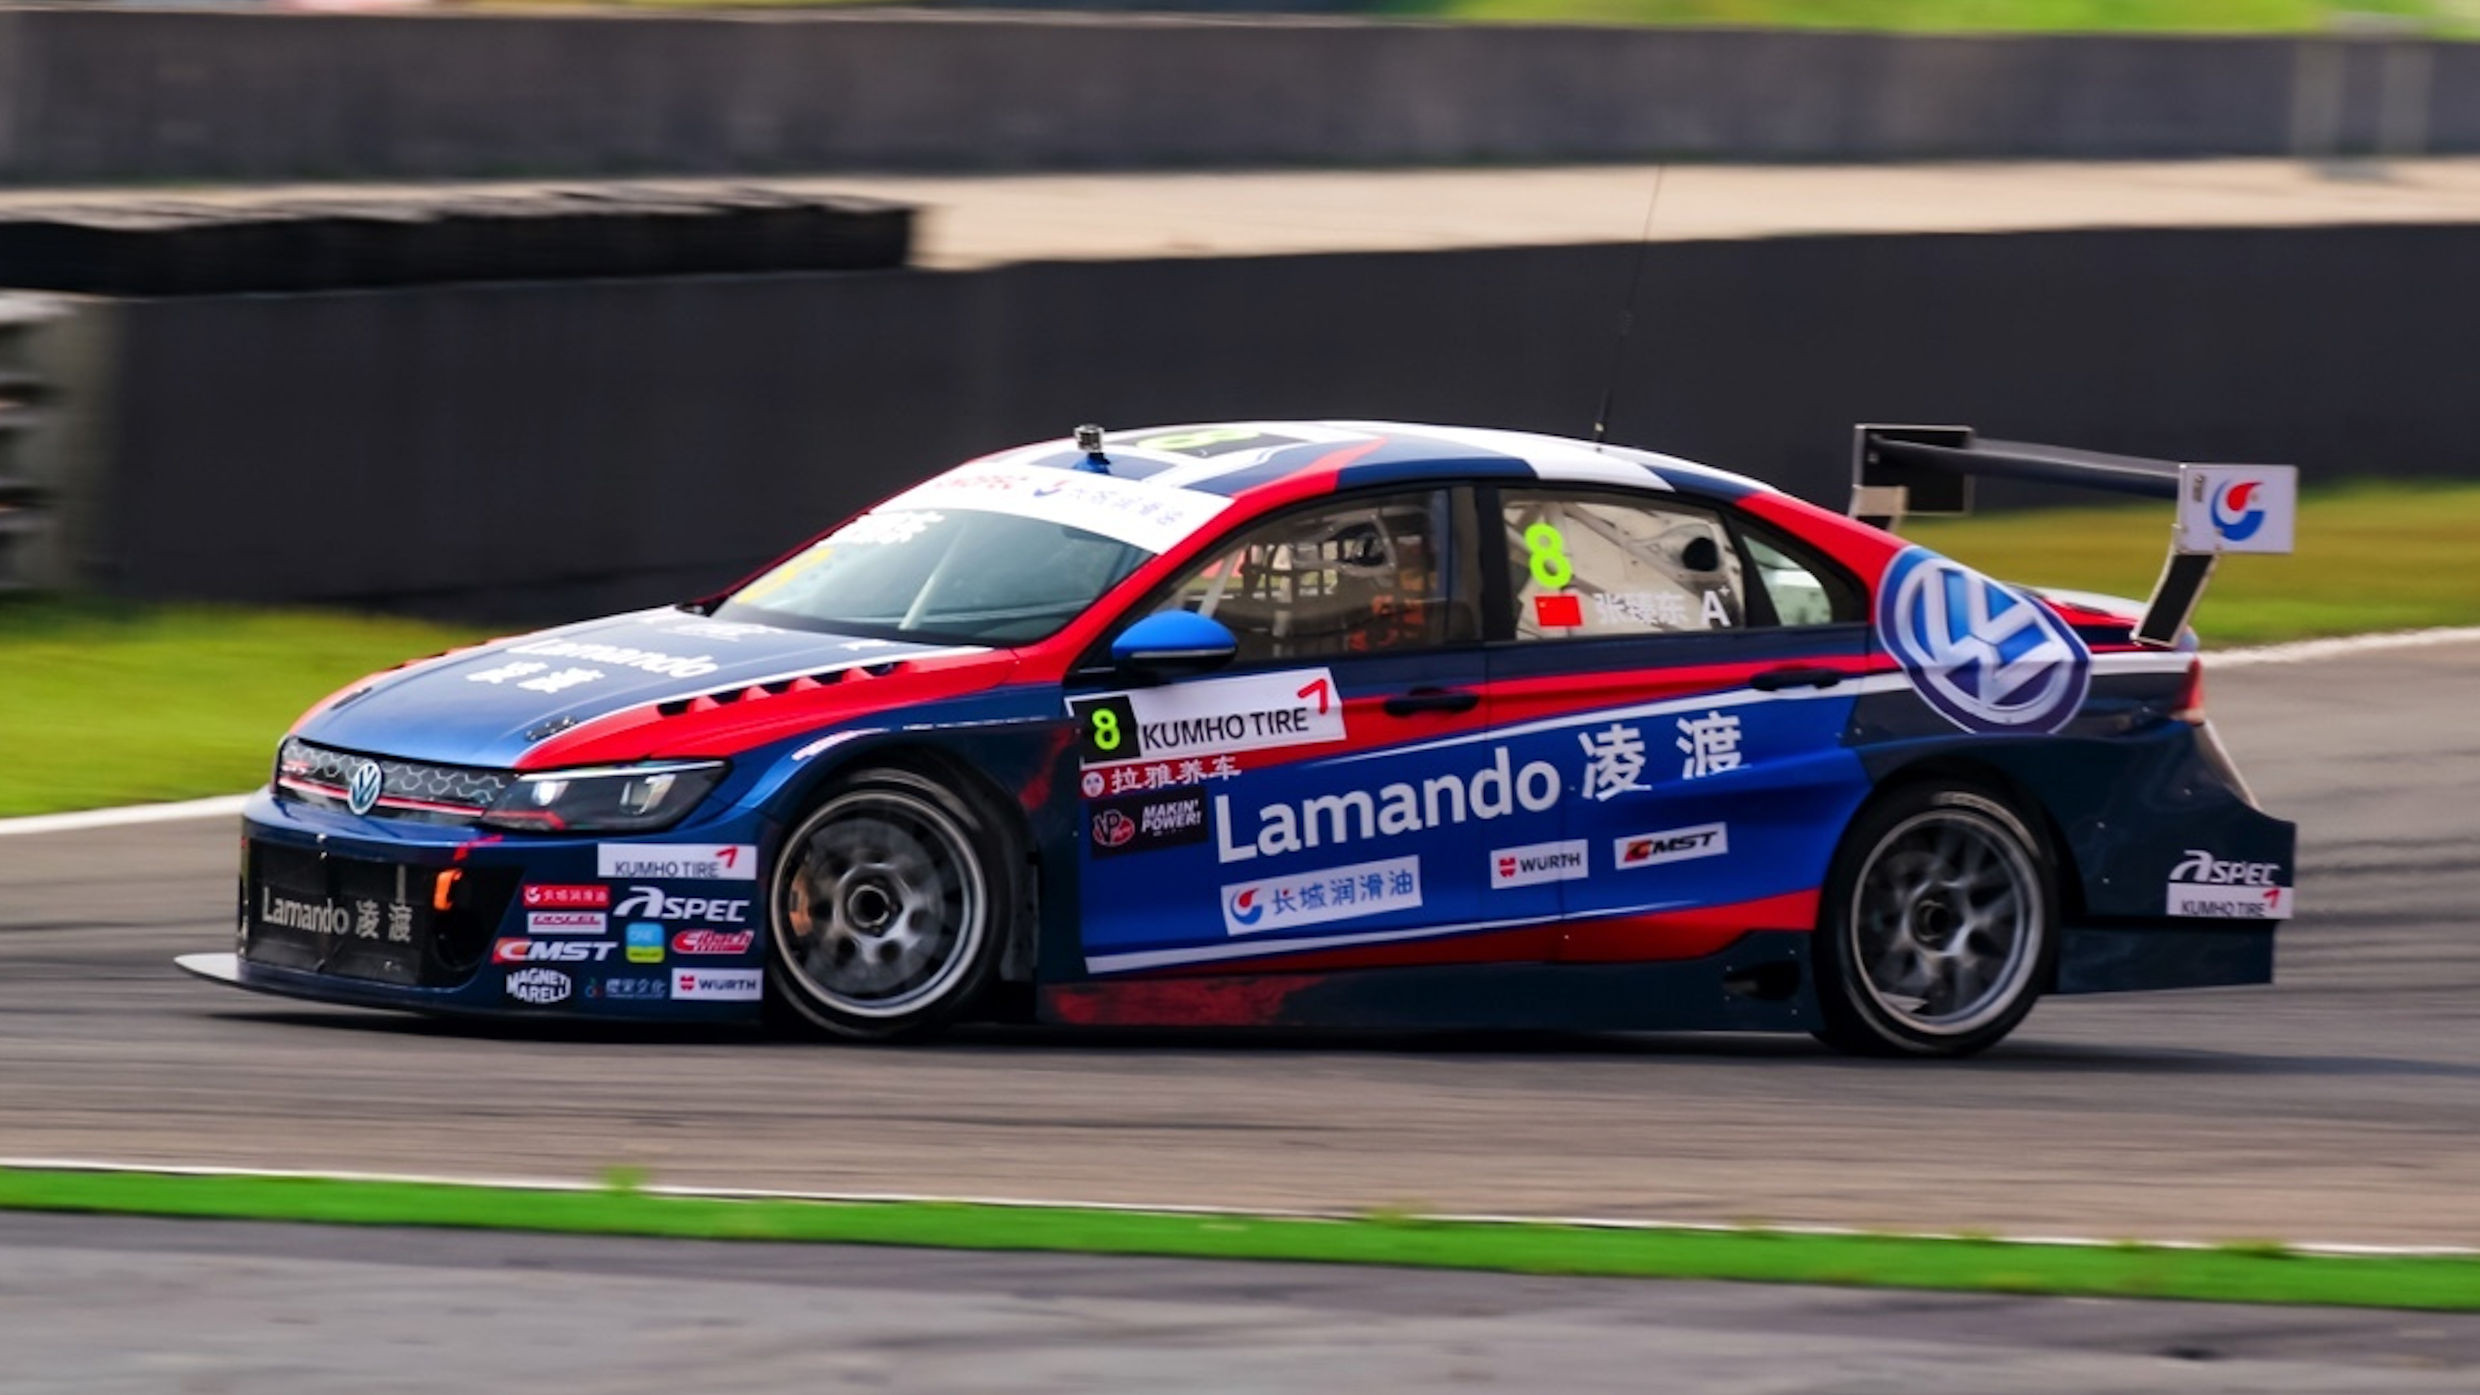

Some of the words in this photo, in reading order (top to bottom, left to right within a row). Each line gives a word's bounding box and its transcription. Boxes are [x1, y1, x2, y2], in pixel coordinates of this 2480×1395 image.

[1524, 522, 1573, 589] 8
[1091, 708, 1121, 751] 8
[1142, 713, 1245, 750] KUMHO
[1249, 707, 1310, 736] TIRE
[1111, 755, 1242, 795] 拉雅养车
[1214, 747, 1561, 864] Lamando
[1577, 711, 1752, 802] 凌渡
[1140, 811, 1202, 833] POWER!
[1624, 830, 1720, 861] CMST
[615, 861, 678, 879] KUMHO
[682, 862, 720, 879] TIRE
[2168, 849, 2281, 886] ASPEC
[613, 886, 751, 922] ASPEC
[1273, 868, 1415, 915] 长城润滑油
[2181, 899, 2234, 918] KUMHO
[2237, 902, 2266, 917] TIRE
[262, 886, 350, 936] Lamando
[355, 899, 414, 943] 凌渡
[499, 940, 618, 962] CMST
